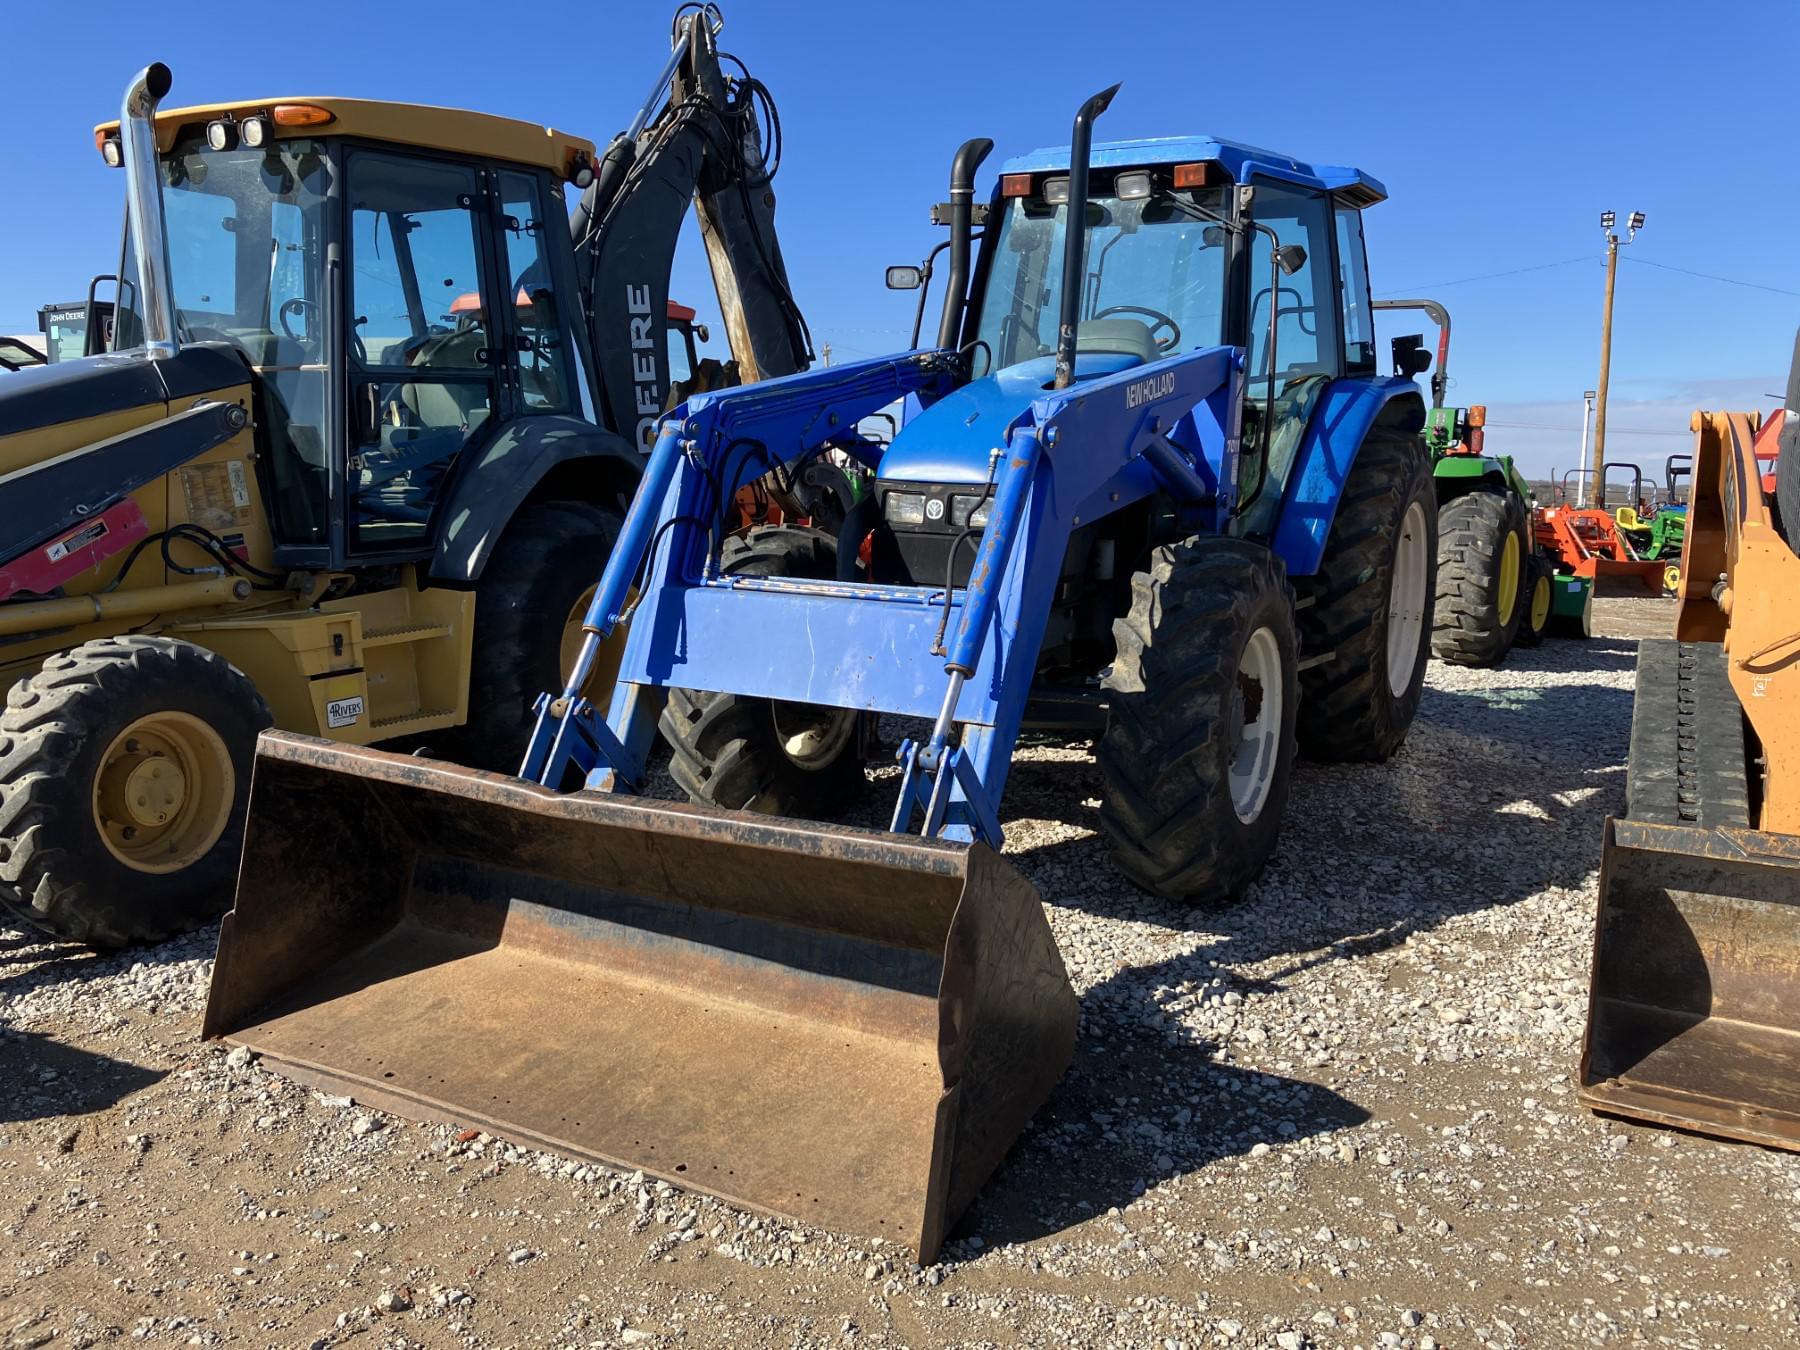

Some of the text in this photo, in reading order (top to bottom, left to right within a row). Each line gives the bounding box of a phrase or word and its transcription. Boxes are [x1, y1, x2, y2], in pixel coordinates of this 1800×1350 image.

[50, 311, 85, 322] JOHN DEERE
[626, 284, 660, 454] DEERE
[1126, 372, 1175, 409] NEW HOLLAND
